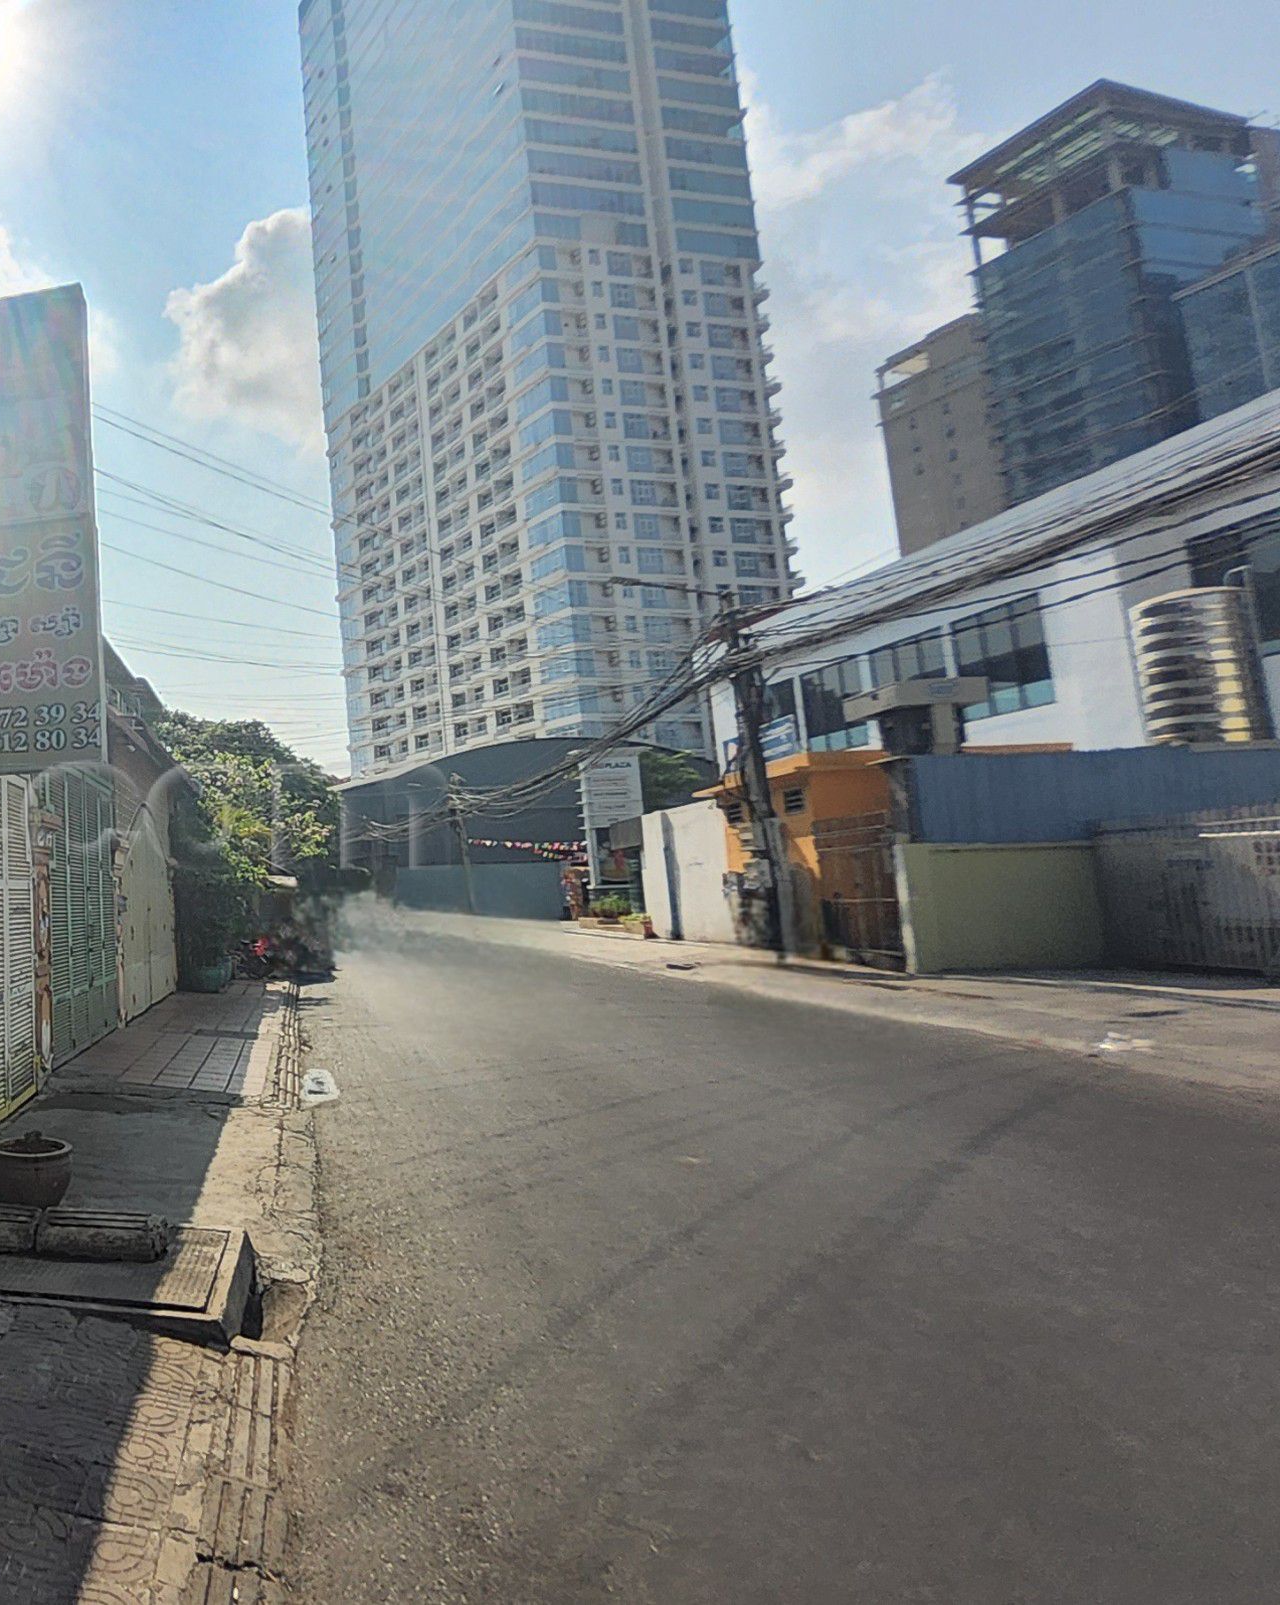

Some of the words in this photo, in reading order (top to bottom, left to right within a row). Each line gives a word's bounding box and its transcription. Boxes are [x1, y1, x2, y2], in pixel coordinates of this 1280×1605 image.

[35, 702, 66, 727] 39
[71, 700, 101, 724] 34
[35, 727, 66, 752] 80
[71, 725, 102, 749] 34
